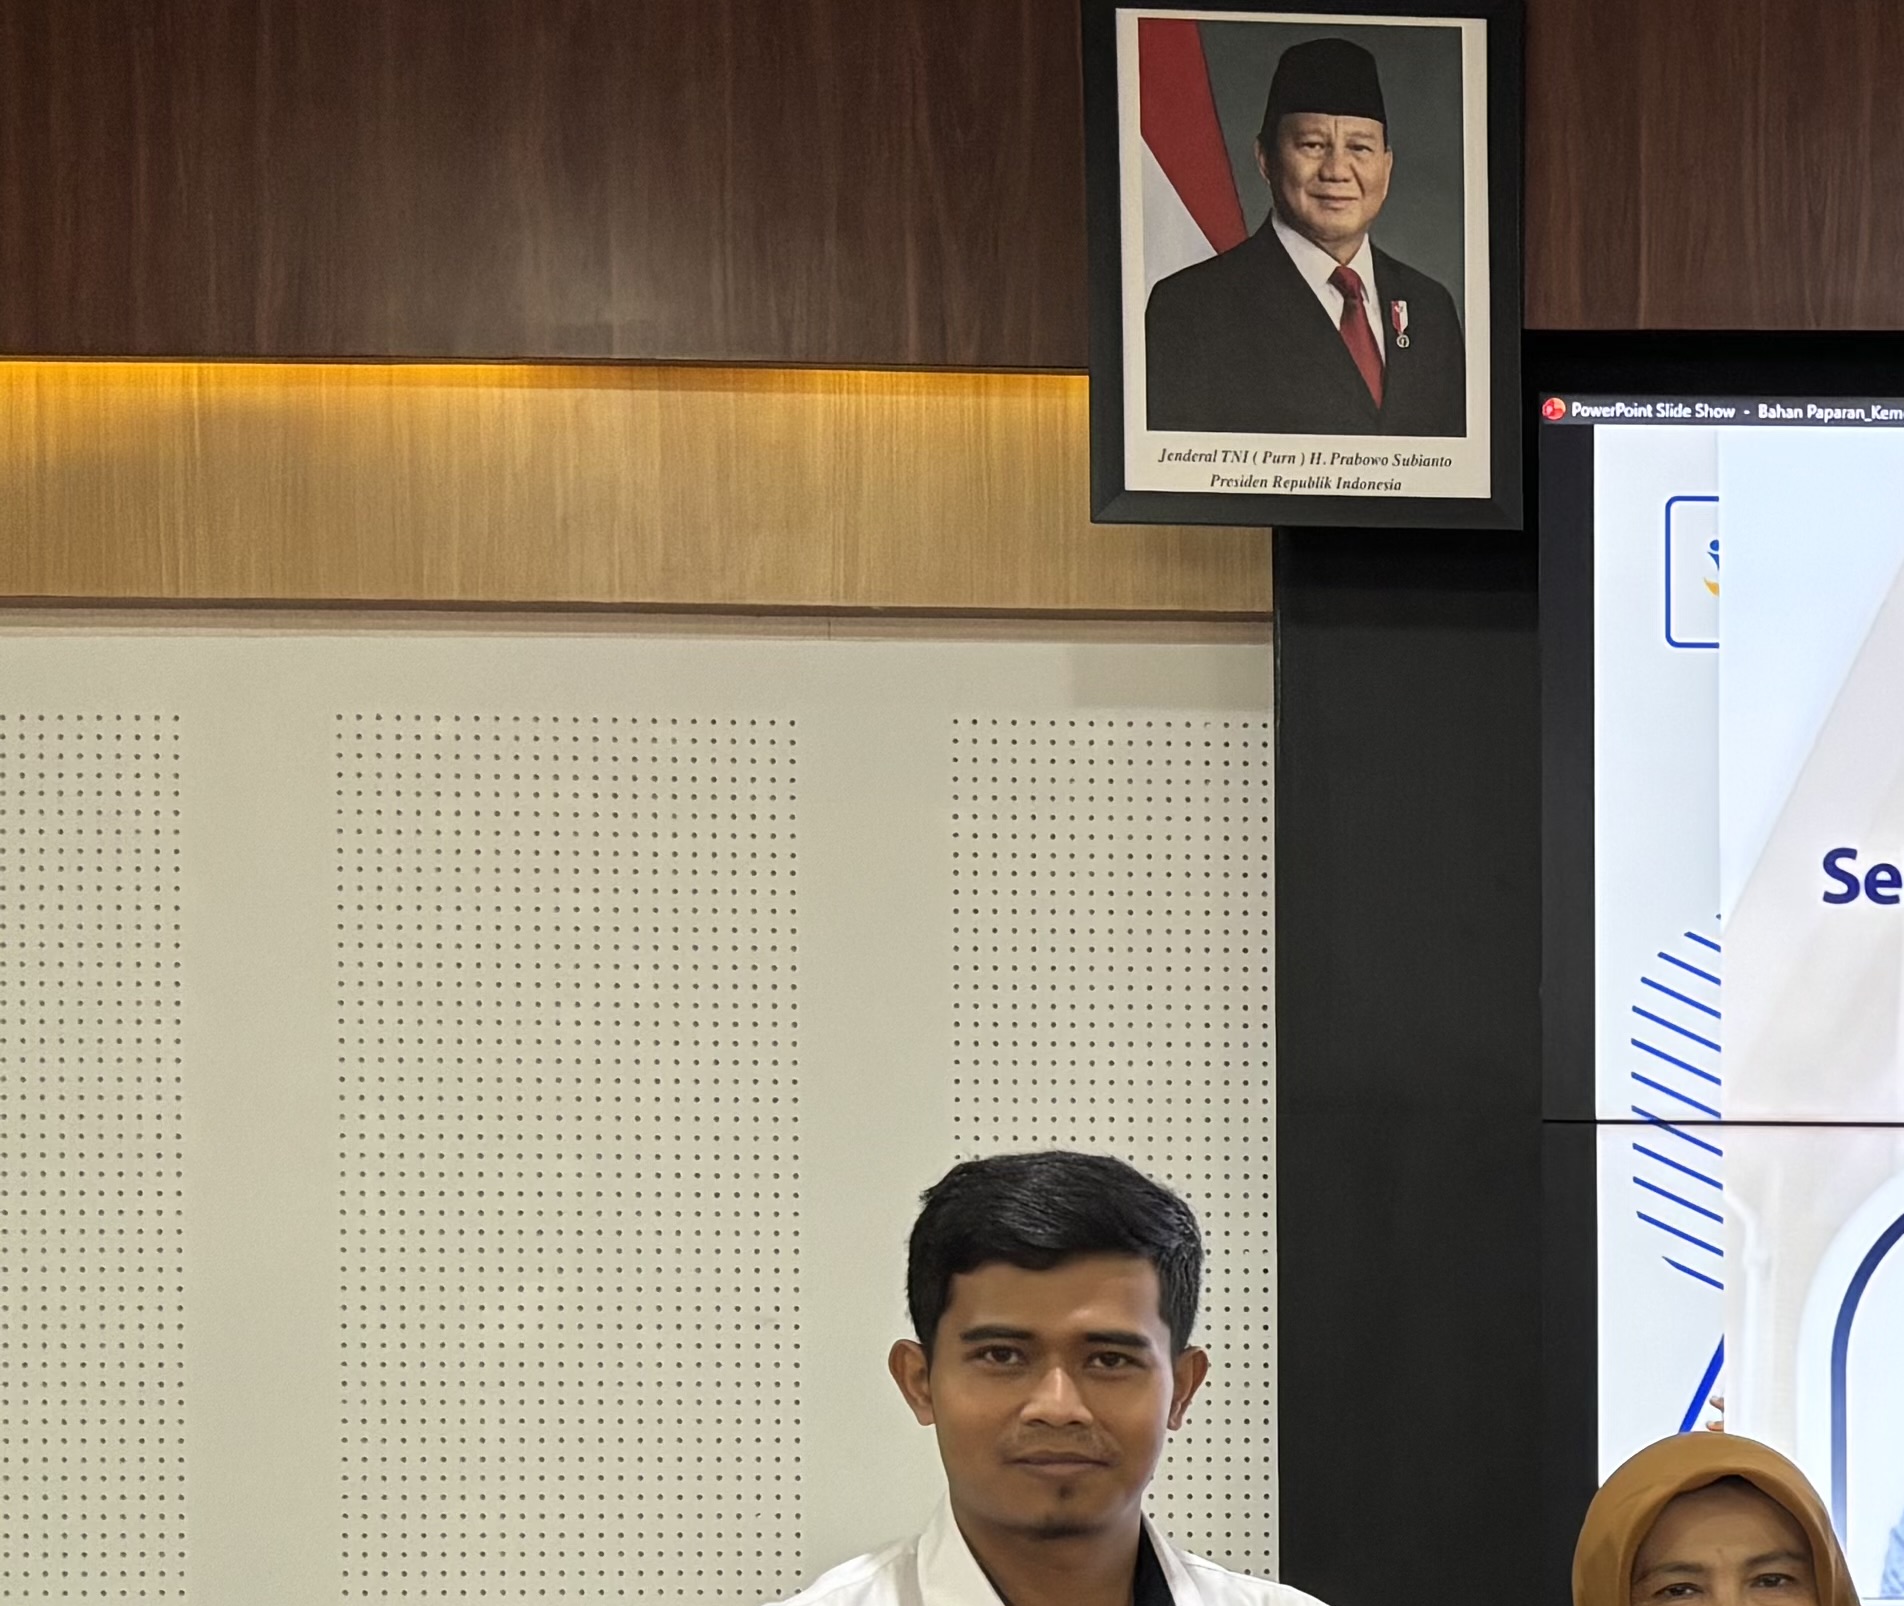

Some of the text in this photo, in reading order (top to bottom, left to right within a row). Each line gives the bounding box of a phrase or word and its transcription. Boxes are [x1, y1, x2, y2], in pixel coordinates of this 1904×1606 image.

[1571, 402, 1653, 418] PowerPoint
[1656, 403, 1692, 418] Slide
[1695, 403, 1736, 418] Show
[1758, 404, 1803, 419] Bahan
[1157, 447, 1218, 463] Jenderal
[1221, 449, 1249, 464] TNI
[1309, 451, 1327, 466] H.
[1329, 451, 1389, 466] Prabowo
[1391, 453, 1453, 468] Subianto
[1210, 473, 1402, 493] Presiden Republik Indonesia
